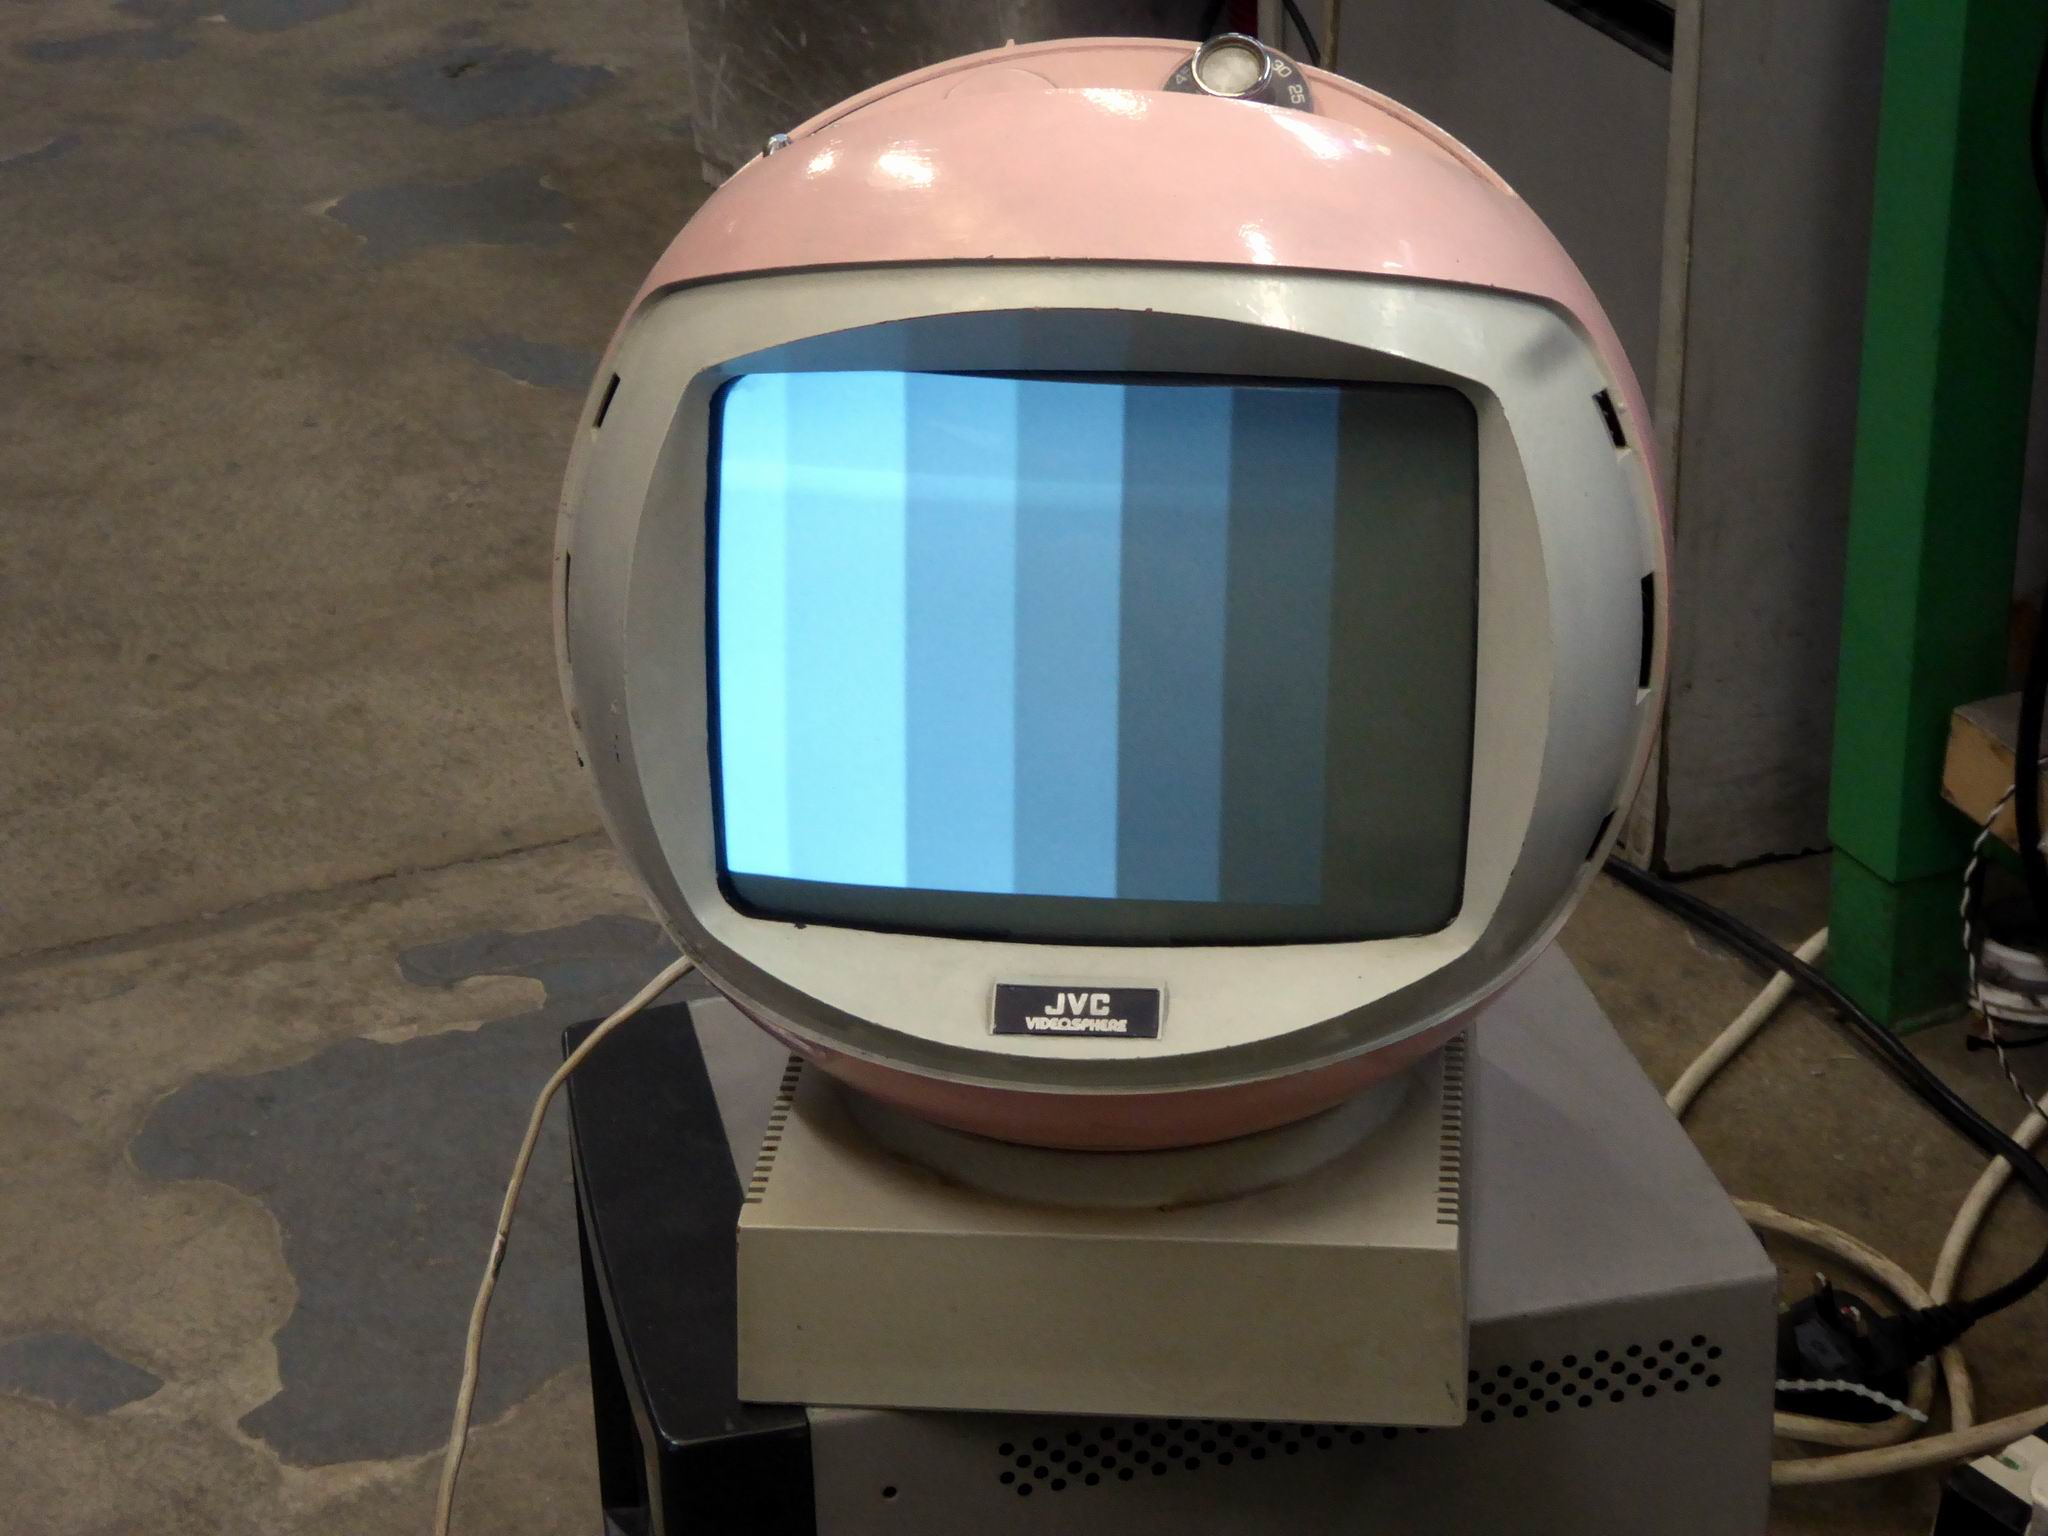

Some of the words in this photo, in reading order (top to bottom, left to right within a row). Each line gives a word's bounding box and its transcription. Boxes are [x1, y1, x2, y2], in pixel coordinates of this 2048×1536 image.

[1271, 59, 1292, 78] 30
[1287, 84, 1305, 104] 25
[1044, 992, 1111, 1016] JVC
[1025, 1016, 1128, 1032] VIDEOSPHERE
